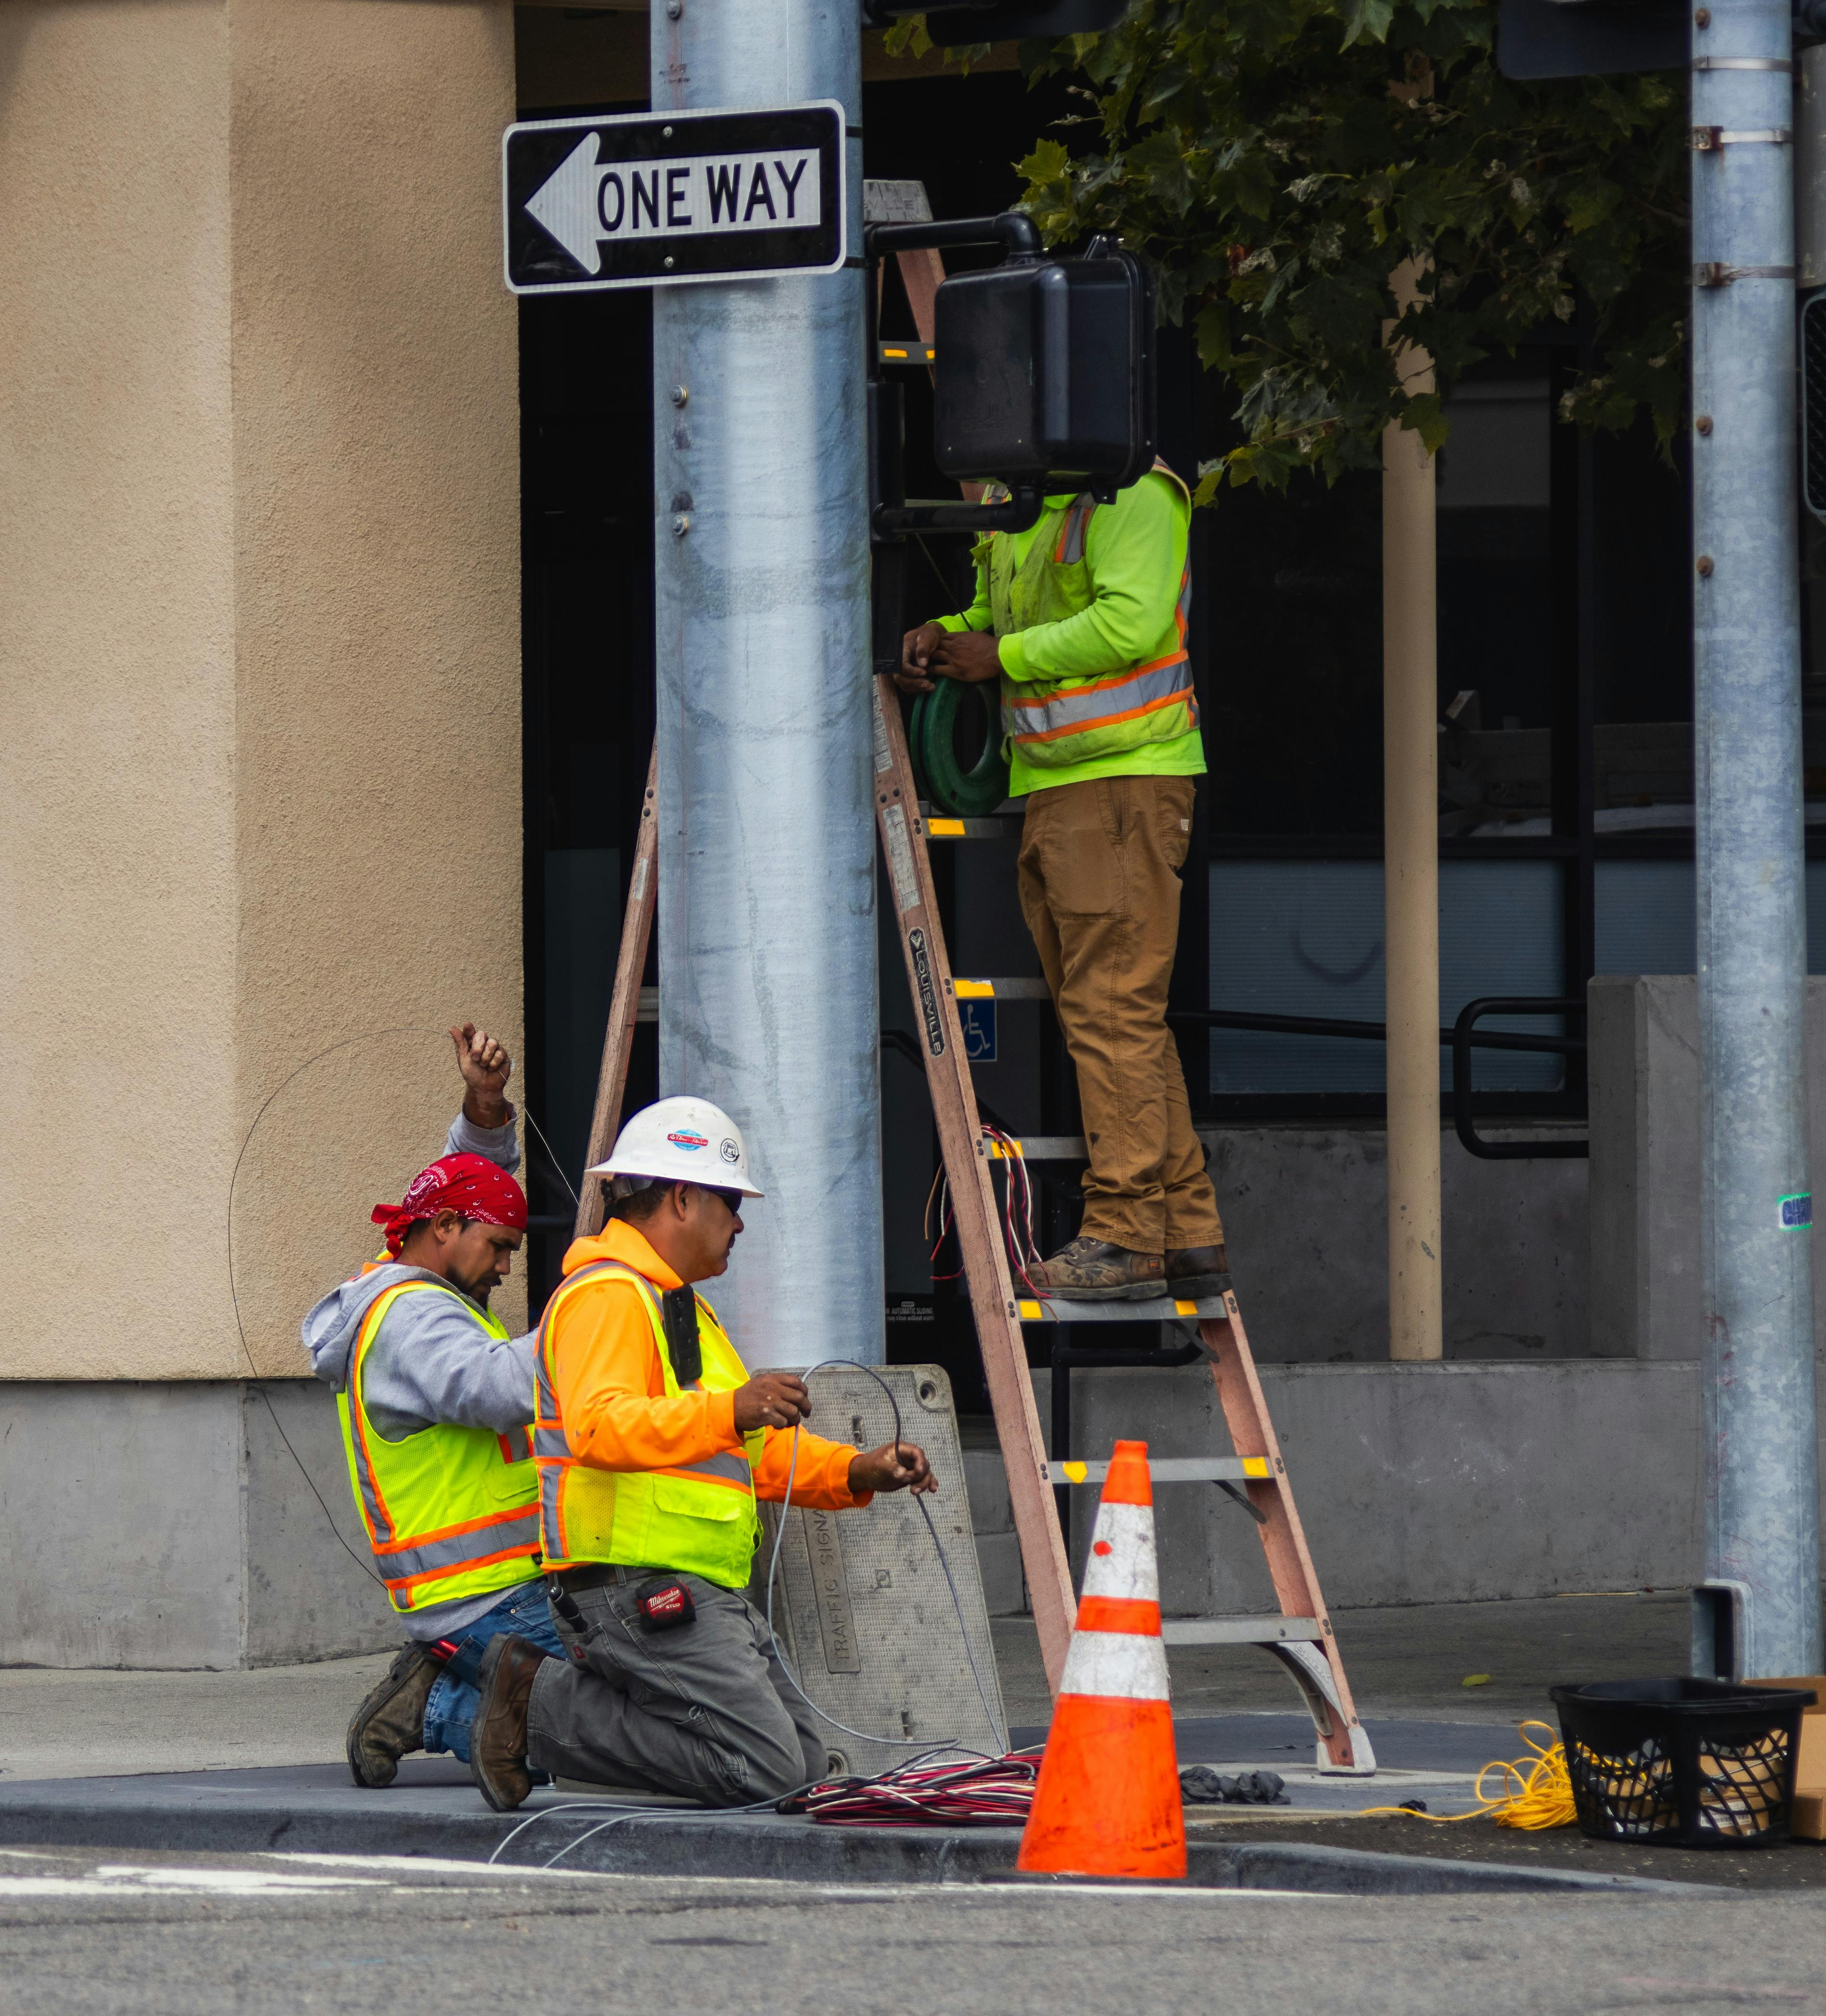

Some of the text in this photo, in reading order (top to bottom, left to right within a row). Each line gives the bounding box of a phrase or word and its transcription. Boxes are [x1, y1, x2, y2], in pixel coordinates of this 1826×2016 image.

[597, 159, 807, 232] ONE WAY
[916, 950, 941, 1053] LOUISVILLE
[648, 1589, 680, 1607] Milwaukee
[824, 1579, 850, 1659] TRAFFIC
